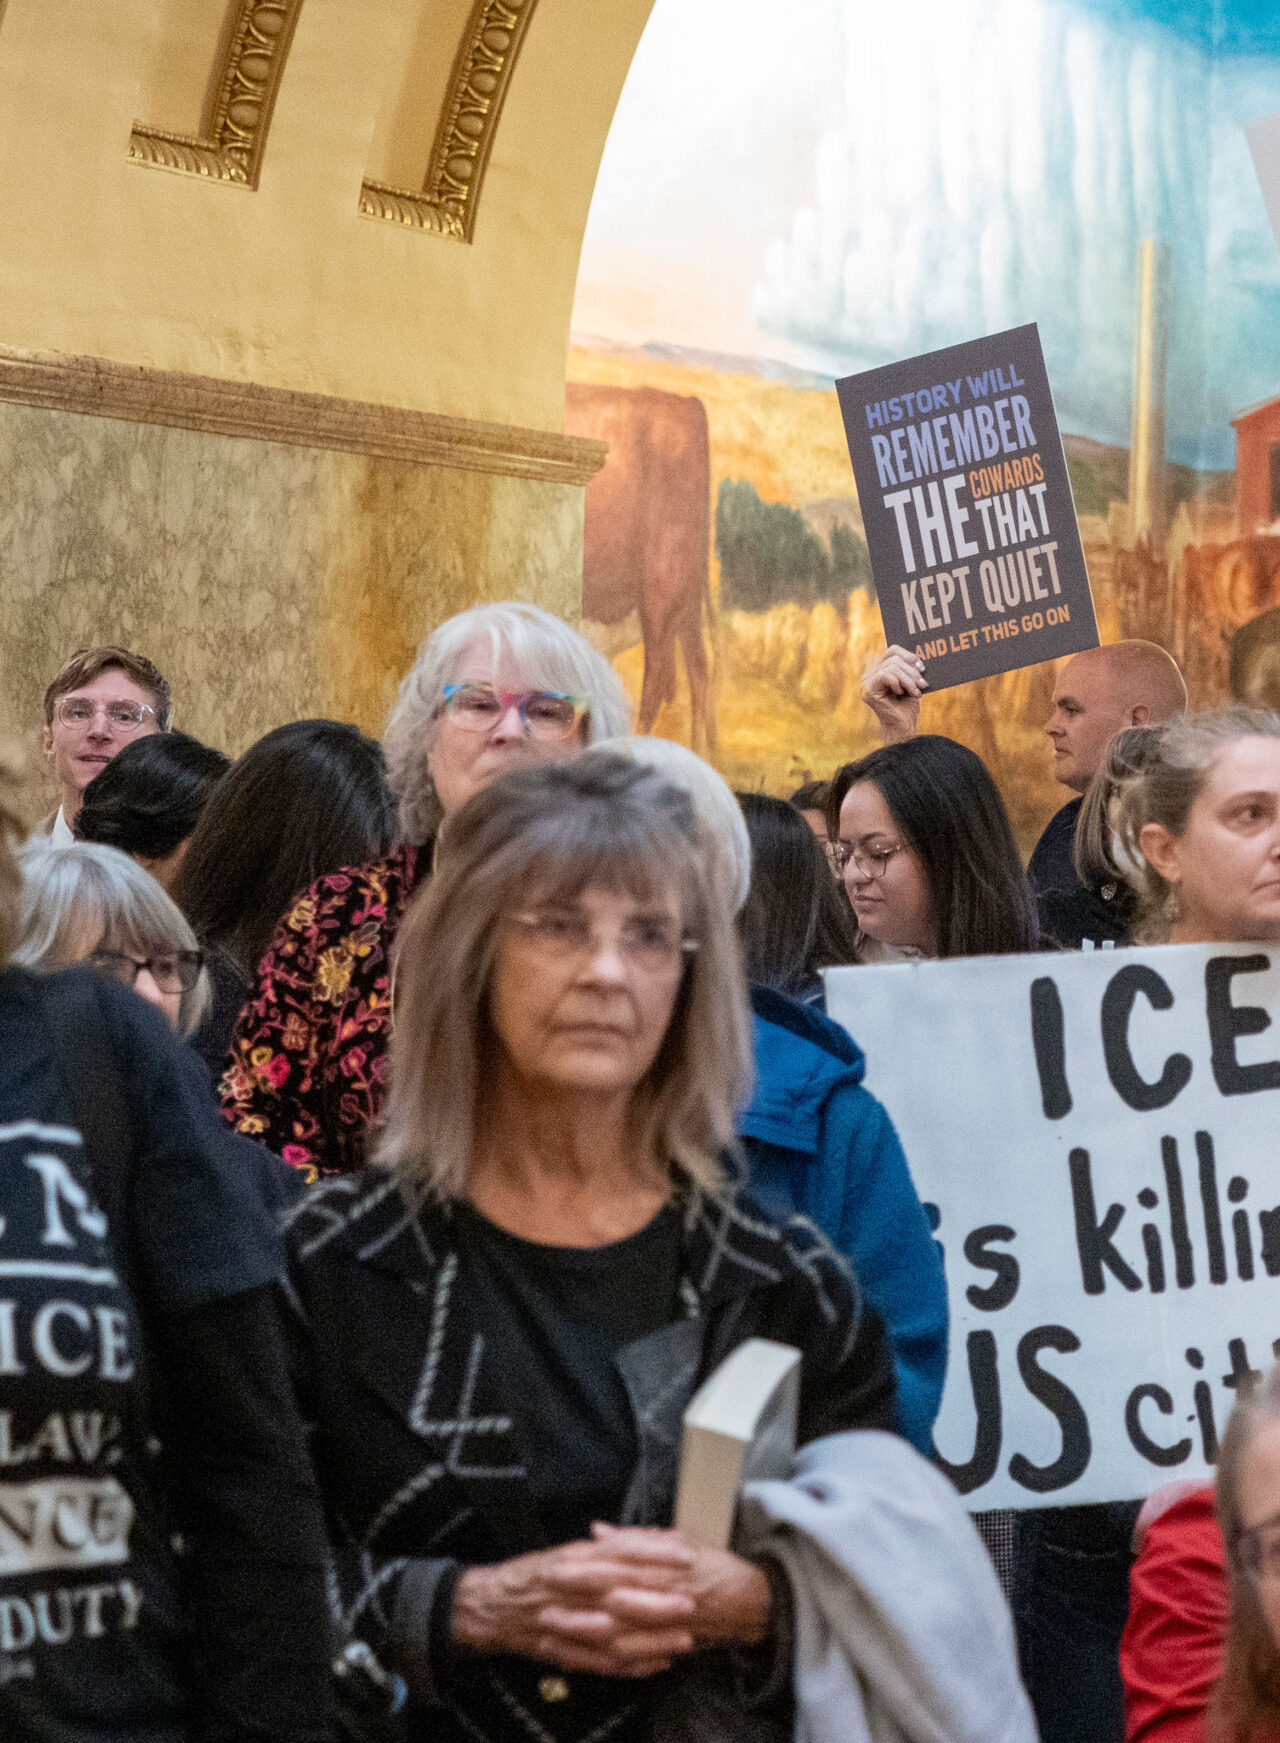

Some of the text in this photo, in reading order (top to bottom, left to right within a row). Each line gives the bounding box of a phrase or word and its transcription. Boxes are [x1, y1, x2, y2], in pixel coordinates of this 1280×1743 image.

[865, 364, 1025, 429] HISTORY WILL
[871, 395, 1037, 488] REMEMBER
[968, 453, 1045, 499] COWARDS
[883, 474, 978, 573] THE
[975, 483, 1051, 551] THAT
[900, 541, 1062, 635] KEPT QUIET
[915, 604, 1071, 661] AND LET THIS GO ON
